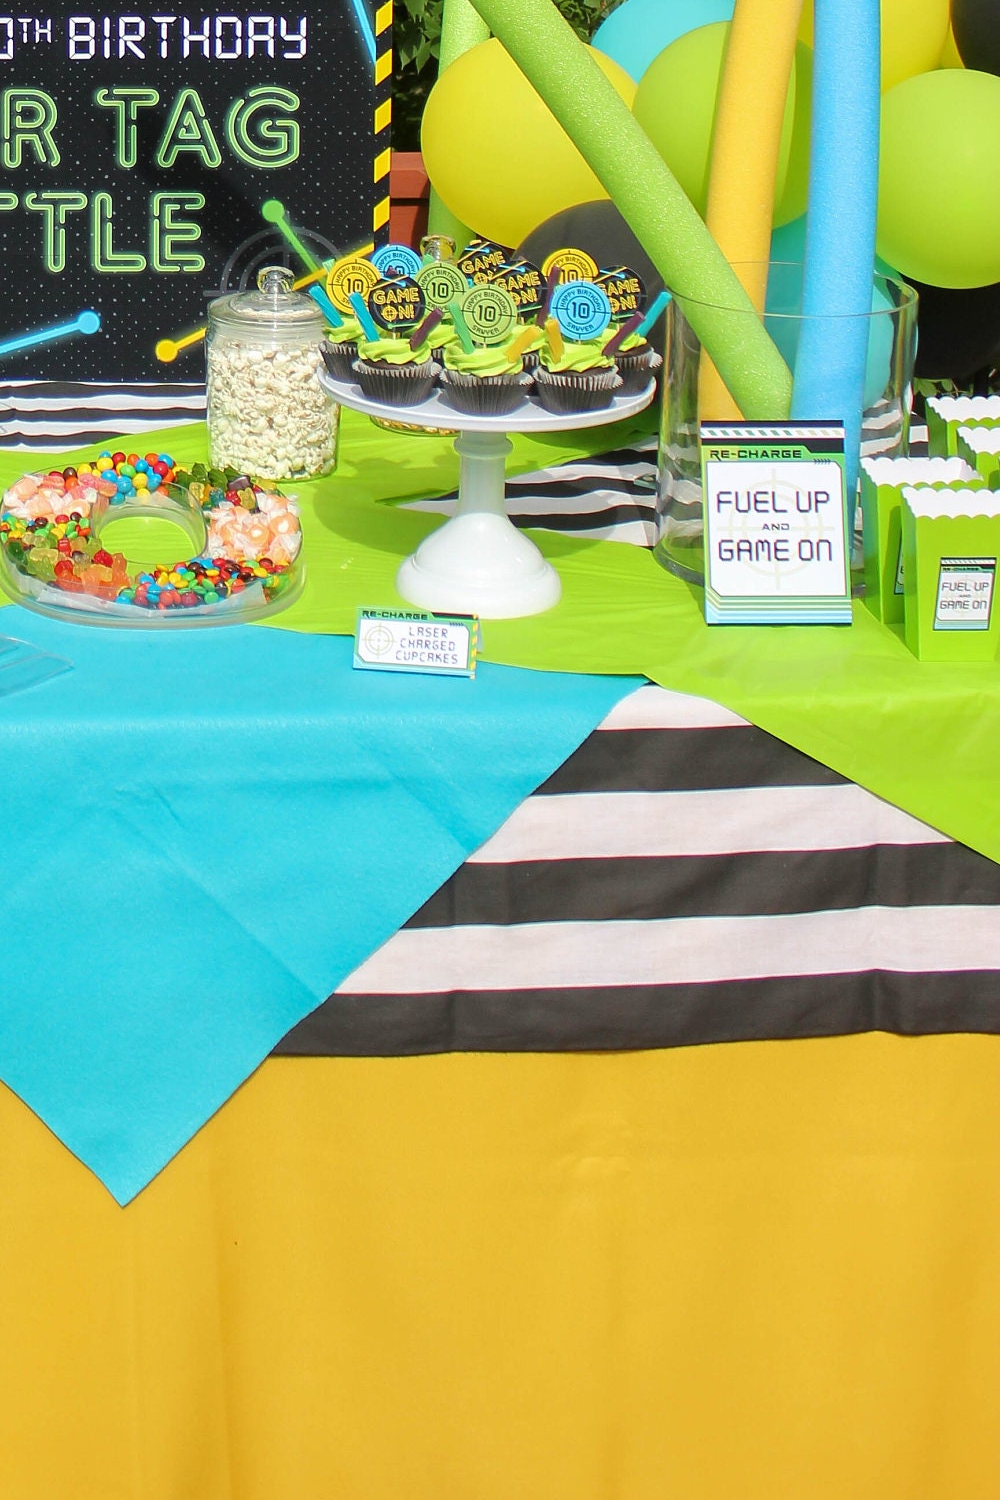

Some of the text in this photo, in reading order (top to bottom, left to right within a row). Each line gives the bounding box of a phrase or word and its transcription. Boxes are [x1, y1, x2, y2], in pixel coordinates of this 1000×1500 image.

[68, 16, 308, 60] BIRTHDAY
[97, 86, 301, 169] TAG
[392, 252, 416, 272] BIRTHDAY
[461, 251, 506, 274] GAME
[565, 256, 590, 275] BIRTHDAY
[335, 265, 350, 284] HAPPY
[420, 270, 435, 288] HAPPY
[435, 269, 461, 289] BIRTHDAY
[346, 278, 364, 294] 10
[431, 282, 449, 298] 10
[373, 287, 420, 305] GAME
[466, 291, 508, 314] HAPPY BIRTHDAY
[560, 288, 602, 311] HAPPY BIRTHDAY
[381, 304, 415, 322] ON!
[478, 305, 496, 322] 10
[571, 301, 590, 319] 10
[472, 325, 500, 335] SAWYER
[566, 321, 595, 332] SAWYER
[710, 450, 802, 461] RE-CHARGE
[716, 491, 830, 513] FUEL UP
[762, 523, 790, 531] AND
[718, 539, 833, 562] GAME ON
[941, 582, 990, 592] FUEL UP
[940, 600, 988, 610] GAME ON
[362, 610, 428, 620] RE-CHARGE
[408, 626, 448, 638] LASER
[400, 638, 456, 651] CHARGED
[395, 650, 458, 664] CUPCAKES
